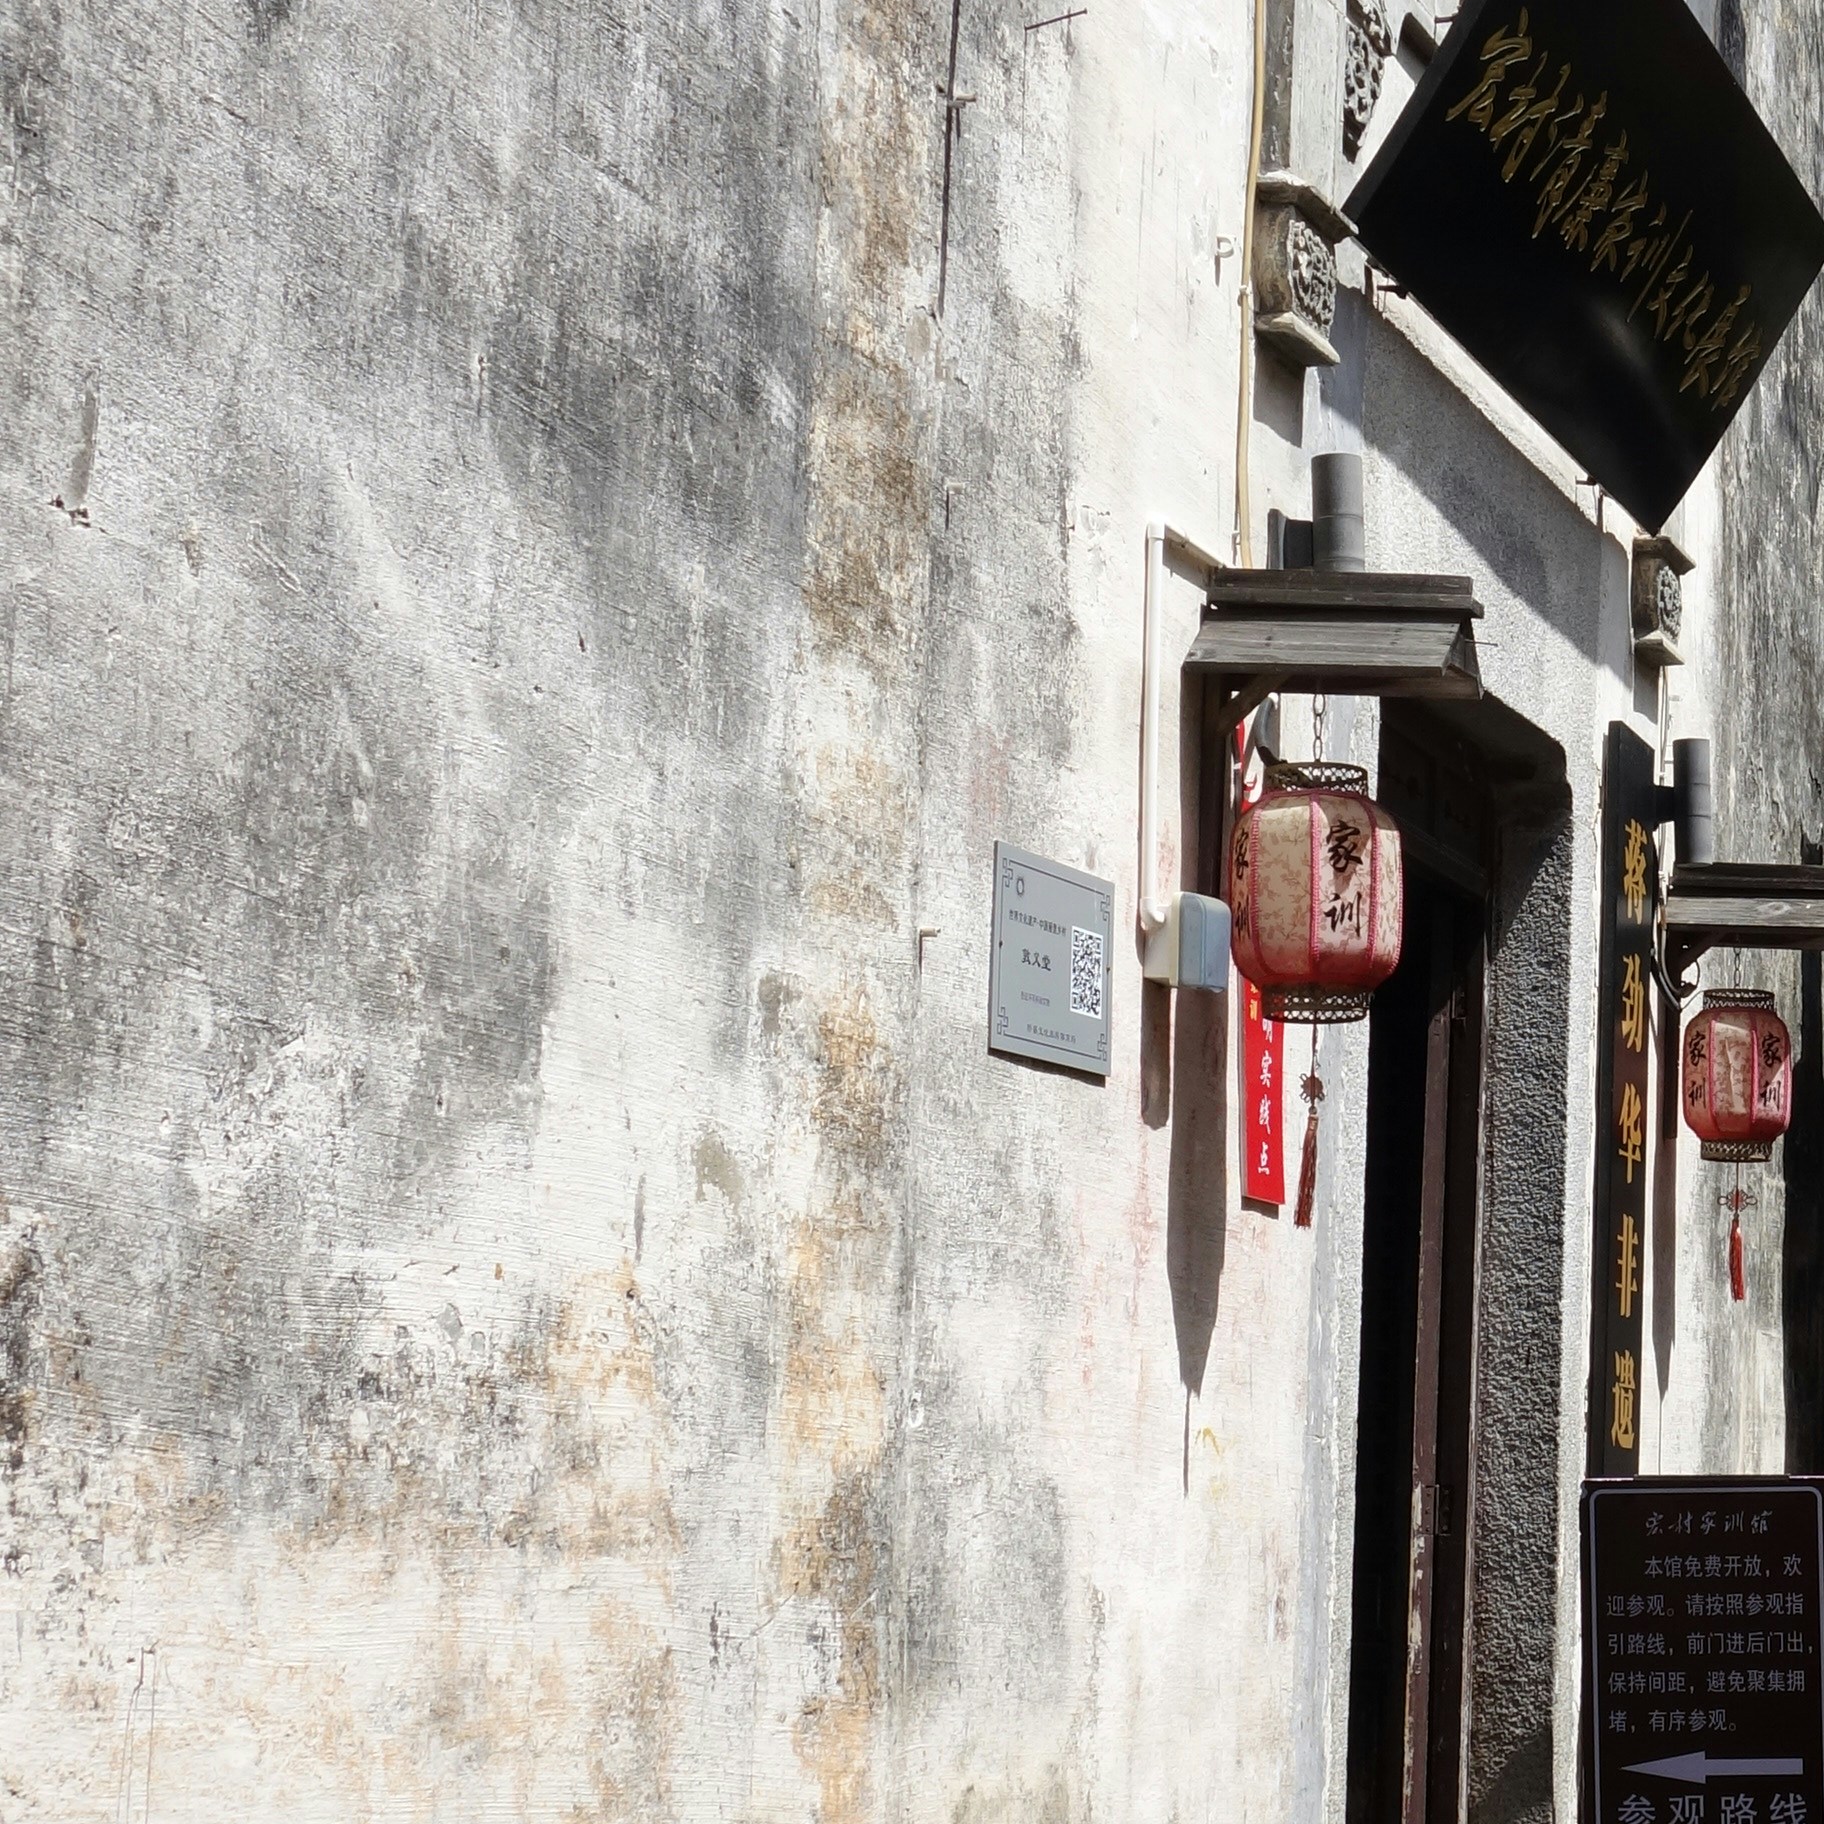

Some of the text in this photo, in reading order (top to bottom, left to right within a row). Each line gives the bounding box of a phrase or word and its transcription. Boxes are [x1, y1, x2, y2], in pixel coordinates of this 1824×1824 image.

[1323, 819, 1364, 938] 家训
[1688, 1031, 1707, 1110] 家训
[1760, 1031, 1783, 1112] 家训
[1644, 1553, 1803, 1578] 本馆免费开放，欢
[1606, 1592, 1805, 1617] 迎参观。请按照参观指
[1607, 1631, 1814, 1656] 引路线，前门进后门出，
[1607, 1669, 1806, 1694] 保持间距，避免聚集拥
[1608, 1709, 1737, 1733] 堵，有序参观。
